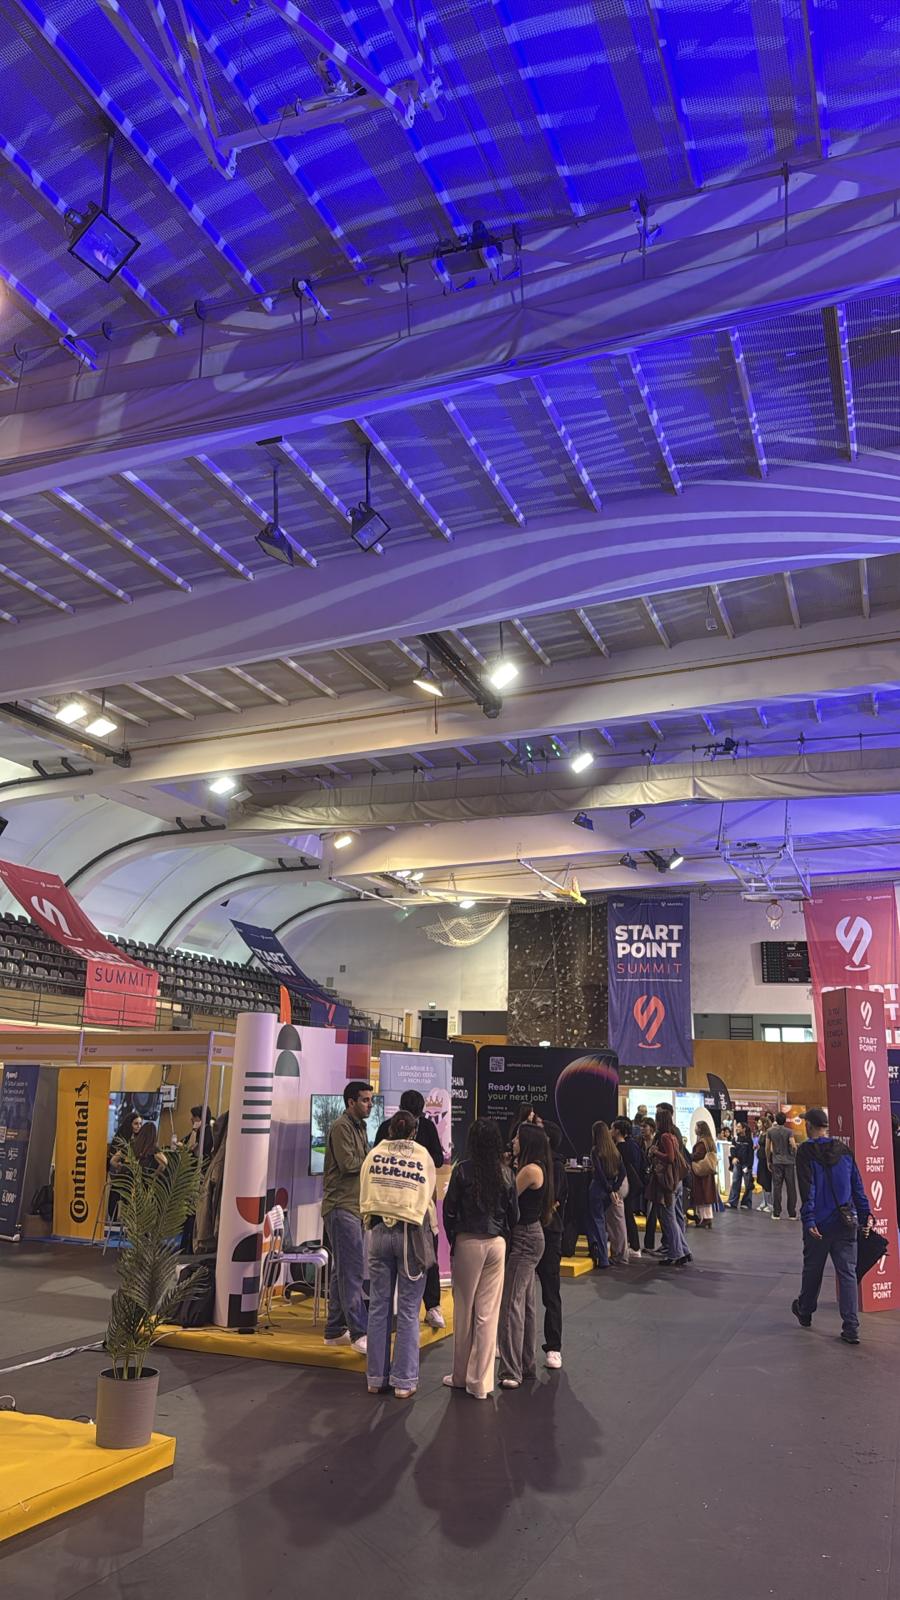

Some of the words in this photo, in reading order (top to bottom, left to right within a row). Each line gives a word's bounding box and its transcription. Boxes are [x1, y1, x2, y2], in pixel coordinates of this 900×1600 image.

[615, 924, 683, 941] START
[617, 942, 681, 958] POINT
[617, 962, 682, 974] SUMMIT
[95, 967, 153, 988] SUMMIT
[858, 1036, 877, 1045] START
[859, 1044, 877, 1053] POINT
[488, 1083, 515, 1093] Ready
[517, 1084, 526, 1092] to
[528, 1084, 547, 1093] land
[451, 1089, 469, 1099] PHOLD
[488, 1092, 508, 1101] your
[530, 1093, 548, 1103] job?
[862, 1096, 881, 1104] START
[863, 1104, 881, 1112] POINT
[69, 1101, 89, 1223] Continental
[866, 1165, 885, 1173] POINT
[369, 1165, 426, 1184] Attitude
[872, 1283, 892, 1291] START
[873, 1291, 892, 1299] POINT
